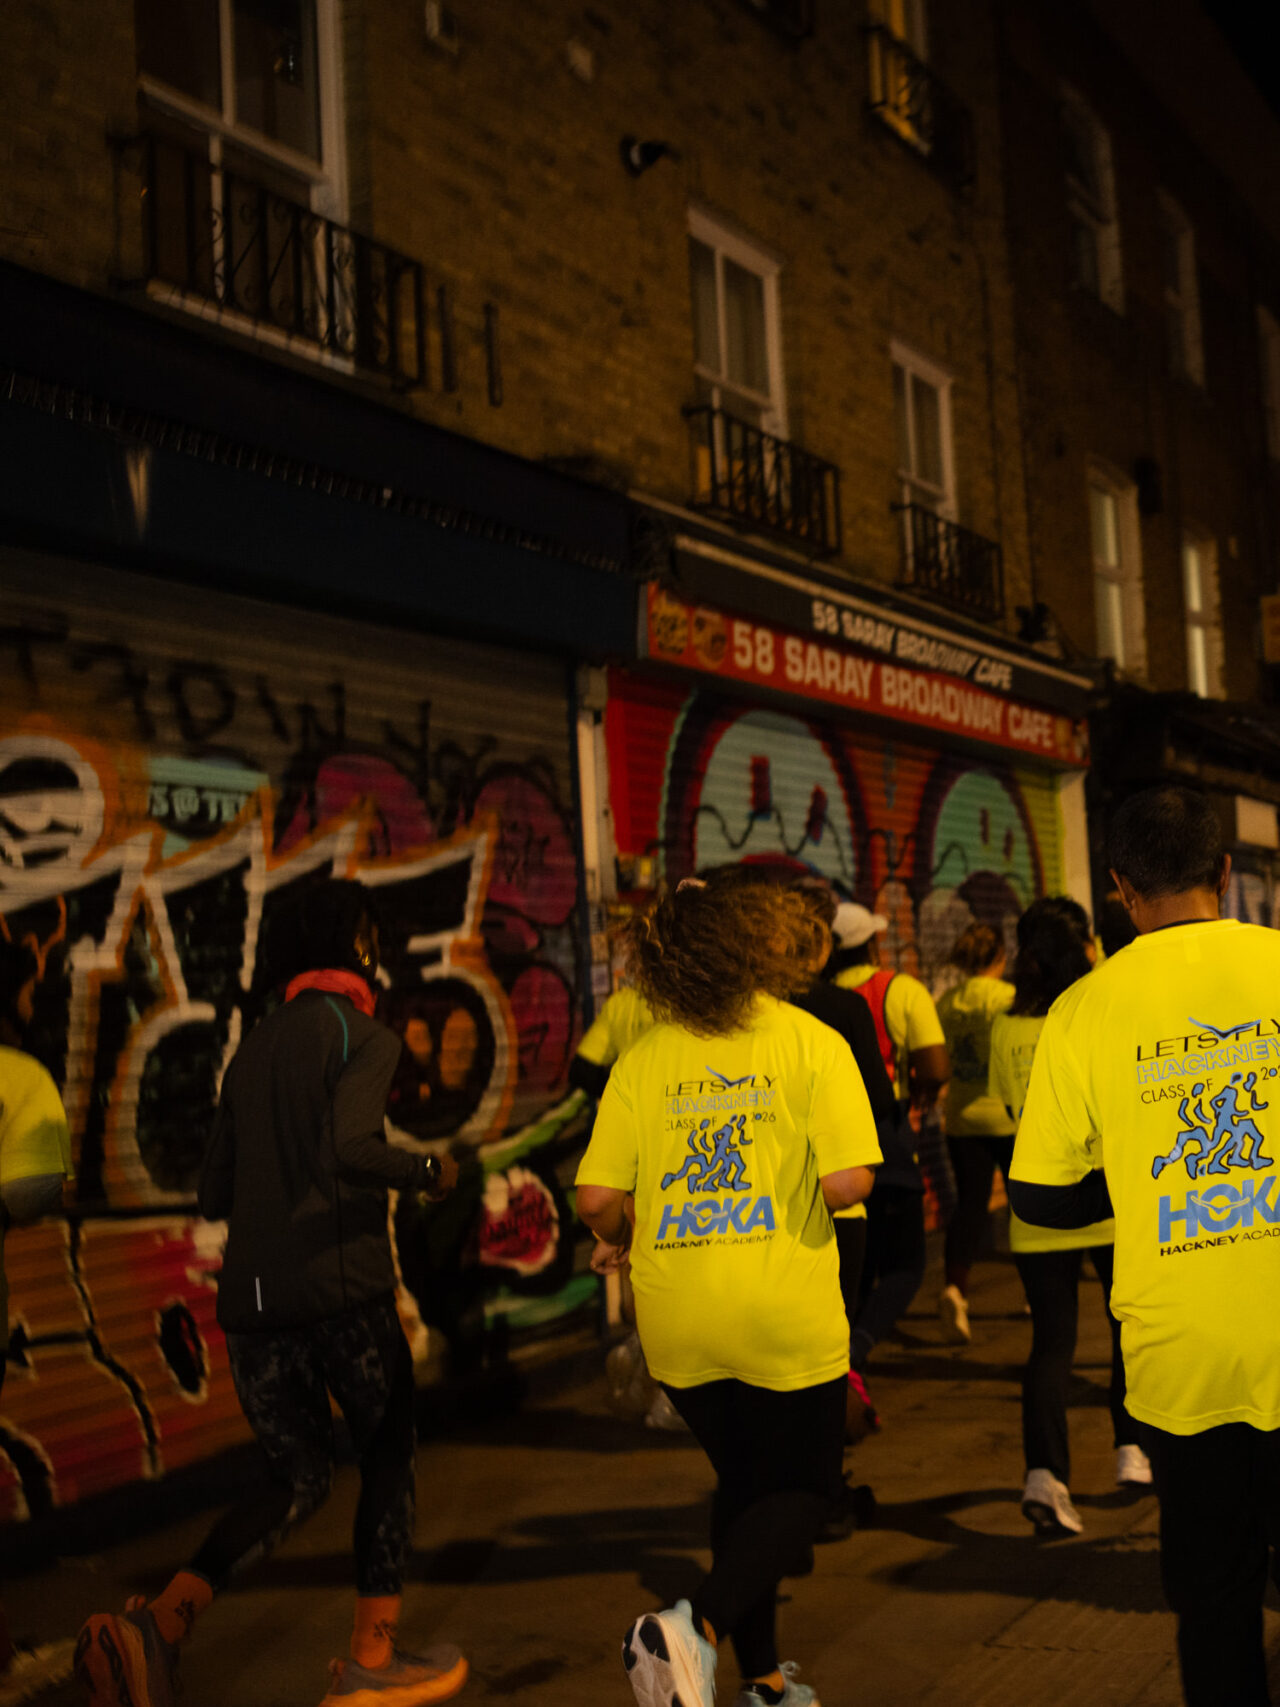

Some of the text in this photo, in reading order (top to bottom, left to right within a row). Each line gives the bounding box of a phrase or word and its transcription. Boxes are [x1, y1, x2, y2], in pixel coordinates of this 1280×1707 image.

[812, 600, 1013, 690] 58 SARAY BROADWAY CAFE
[733, 621, 1053, 749] 58 SARAY BROADWAY CAFE
[1136, 1031, 1219, 1061] LETS
[665, 1075, 778, 1097] LETS FLY
[1140, 1083, 1186, 1104] CLASS
[666, 1090, 776, 1115] HACKNEY
[664, 1118, 696, 1132] CLASS
[656, 1196, 776, 1240] HOKA
[654, 1233, 776, 1251] HACKNEY ACADEMY
[1160, 1233, 1239, 1257] HACKNEY
